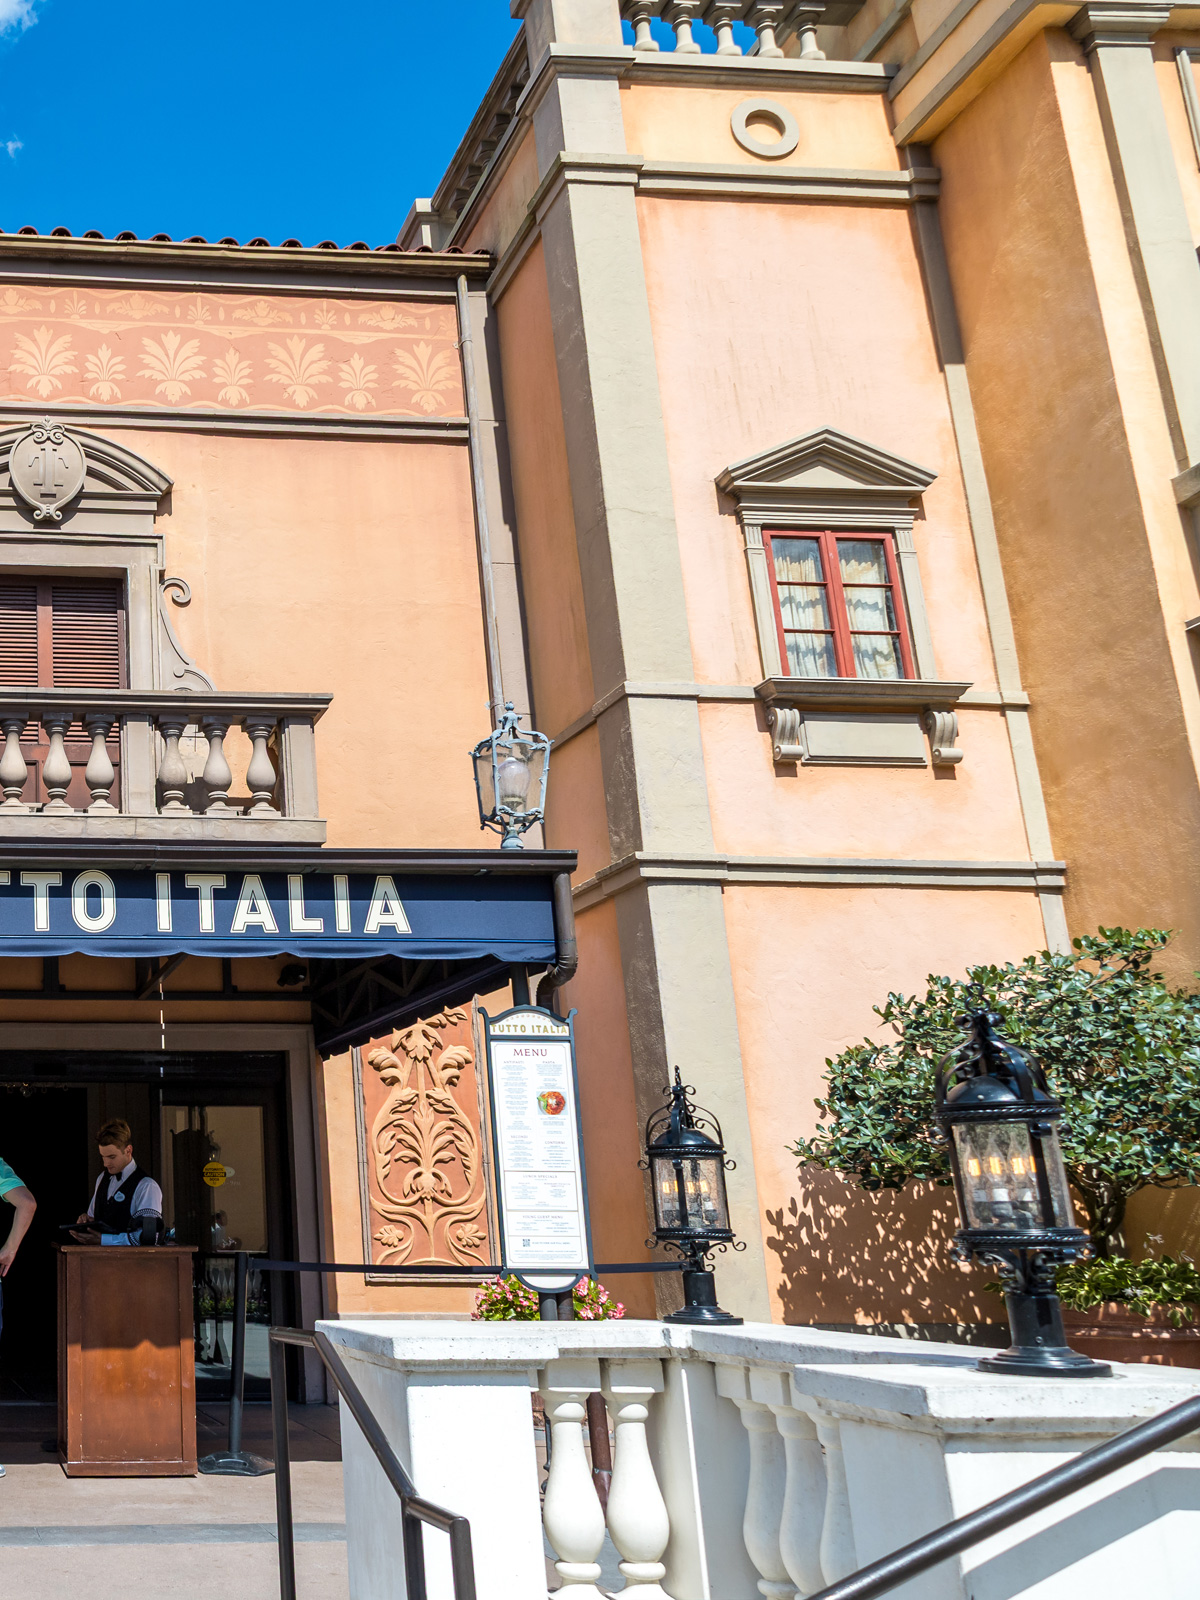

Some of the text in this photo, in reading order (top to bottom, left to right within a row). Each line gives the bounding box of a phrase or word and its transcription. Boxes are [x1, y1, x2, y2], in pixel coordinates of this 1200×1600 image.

[156, 872, 412, 934] ITALIA
[491, 1024, 567, 1034] TUTTO ITALIA
[513, 1048, 548, 1057] MENU
